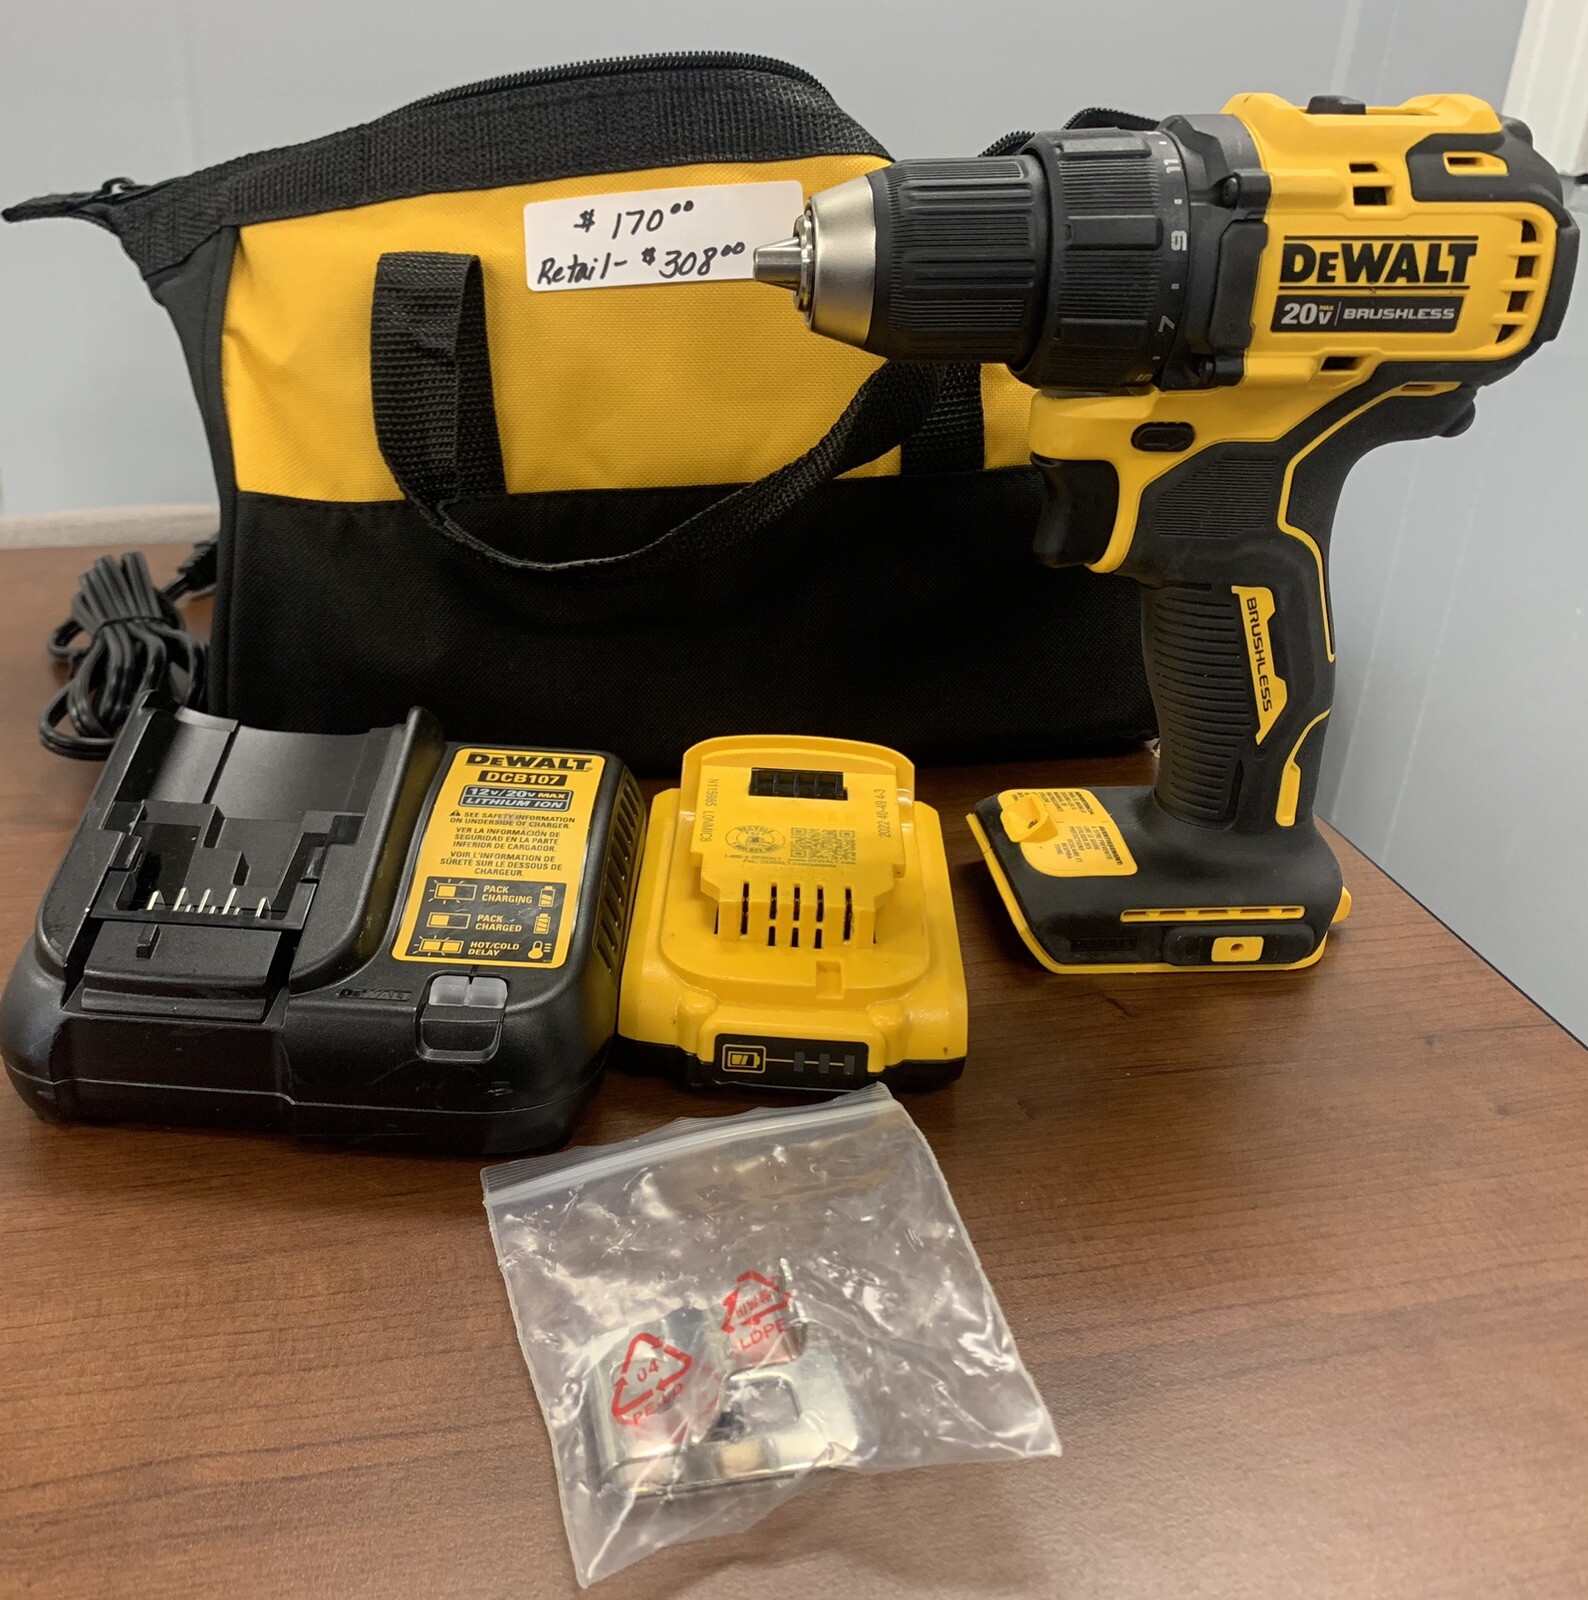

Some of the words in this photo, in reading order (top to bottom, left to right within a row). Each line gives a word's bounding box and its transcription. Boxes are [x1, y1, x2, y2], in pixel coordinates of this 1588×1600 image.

[1163, 159, 1181, 173] 11
[1280, 243, 1478, 283] DEWALT
[1342, 308, 1456, 320] BRUSHLESS
[1158, 315, 1175, 333] 7
[1246, 597, 1273, 712] BRUSHLESS
[465, 753, 593, 771] DEWALT
[485, 771, 560, 785] DCB107
[537, 791, 566, 799] MAX
[465, 797, 529, 807] LITHIUM
[533, 800, 563, 809] ION
[464, 818, 514, 827] UNDERSIDE
[528, 821, 571, 829] CHARGER.
[515, 814, 576, 823] INFORMATION
[486, 828, 547, 837] INFORMACIÓN
[454, 833, 503, 842] SEGURIDAD
[532, 837, 559, 845] PARTE
[452, 841, 492, 849] INFERIOR
[473, 851, 543, 862] L'INFORMATION
[507, 861, 549, 870] DESSOUS
[483, 885, 509, 893] PACK
[481, 894, 533, 904] CHARGING
[477, 914, 503, 923] PACK
[475, 923, 522, 932] CHARGED
[470, 941, 520, 950] HOT/COLD
[338, 988, 412, 1000] DEWALT
[739, 1317, 787, 1350] LDPE
